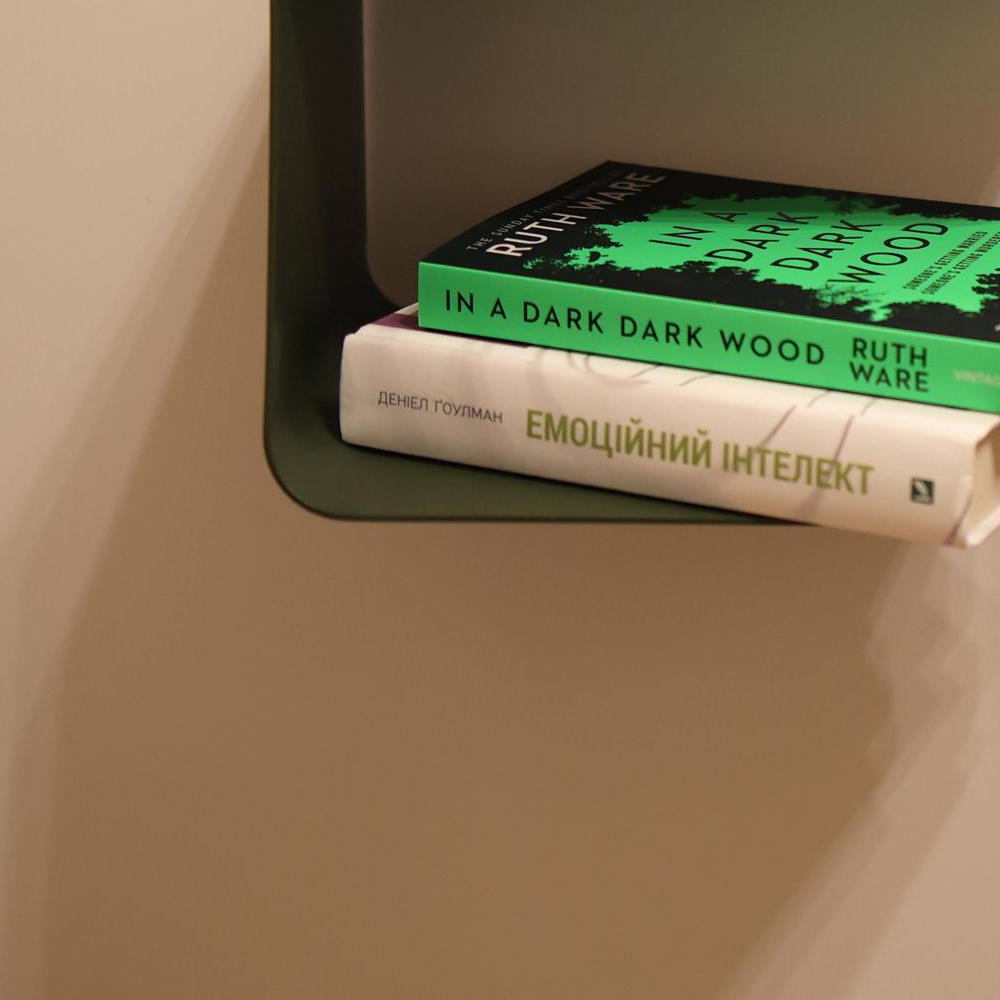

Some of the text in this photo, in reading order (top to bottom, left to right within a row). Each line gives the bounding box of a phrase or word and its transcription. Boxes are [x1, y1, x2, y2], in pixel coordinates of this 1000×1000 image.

[466, 237, 493, 250] THE
[491, 214, 534, 236] SUNDAY
[486, 212, 587, 257] RUTH
[567, 172, 667, 211] WARE
[648, 211, 747, 247] IN A
[704, 212, 819, 262] DARK
[770, 220, 883, 271] DARK
[827, 223, 949, 284] WOOD
[445, 289, 824, 365] IN A DARK DARK WOOD
[849, 361, 929, 393] WARE
[852, 337, 928, 368] RUTH
[377, 391, 503, 424] ДЕНІЕЛ ҐОУЛМАН
[526, 408, 875, 496] ЕМОЦІЙНИЙ ІНТЕЛЕКТ
